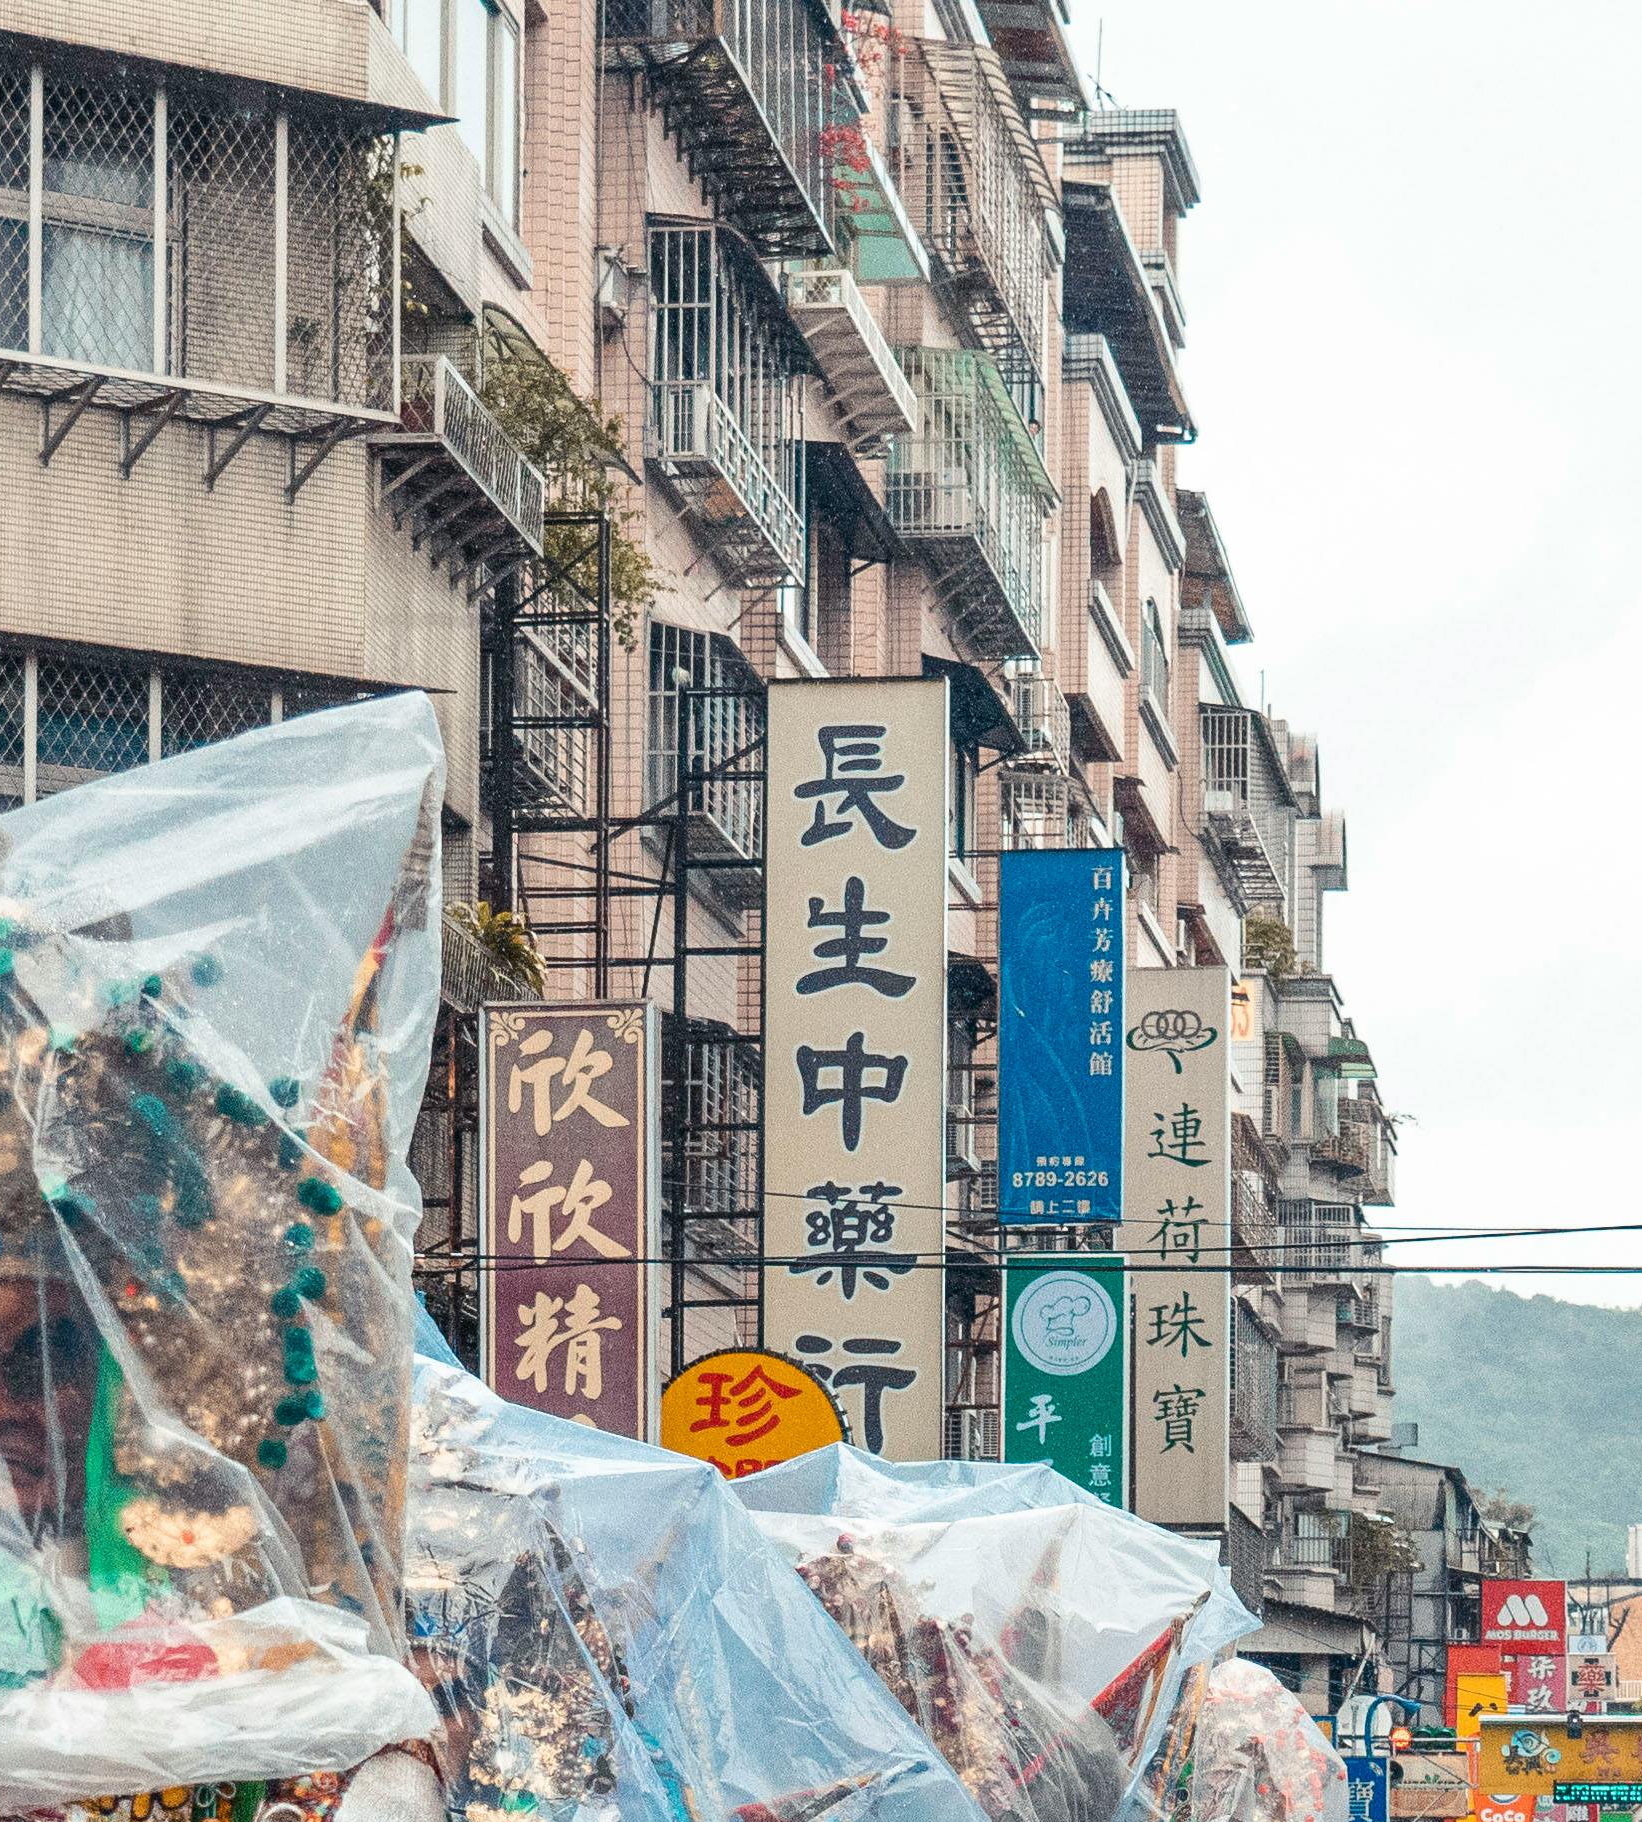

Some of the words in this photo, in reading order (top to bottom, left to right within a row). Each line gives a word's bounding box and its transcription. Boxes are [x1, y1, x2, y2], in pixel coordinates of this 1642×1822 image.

[1089, 865, 1114, 1076] 百卉芳療舒活館
[788, 723, 918, 1455] 長生中藥行
[1012, 1171, 1109, 1188] 8789-2626
[507, 1029, 633, 1428] 欣欣精
[1146, 1102, 1213, 1454] 連荷珠寶
[690, 1364, 803, 1479] 珍
[1485, 1630, 1512, 1640] MOS
[1513, 1630, 1559, 1641] BURGER
